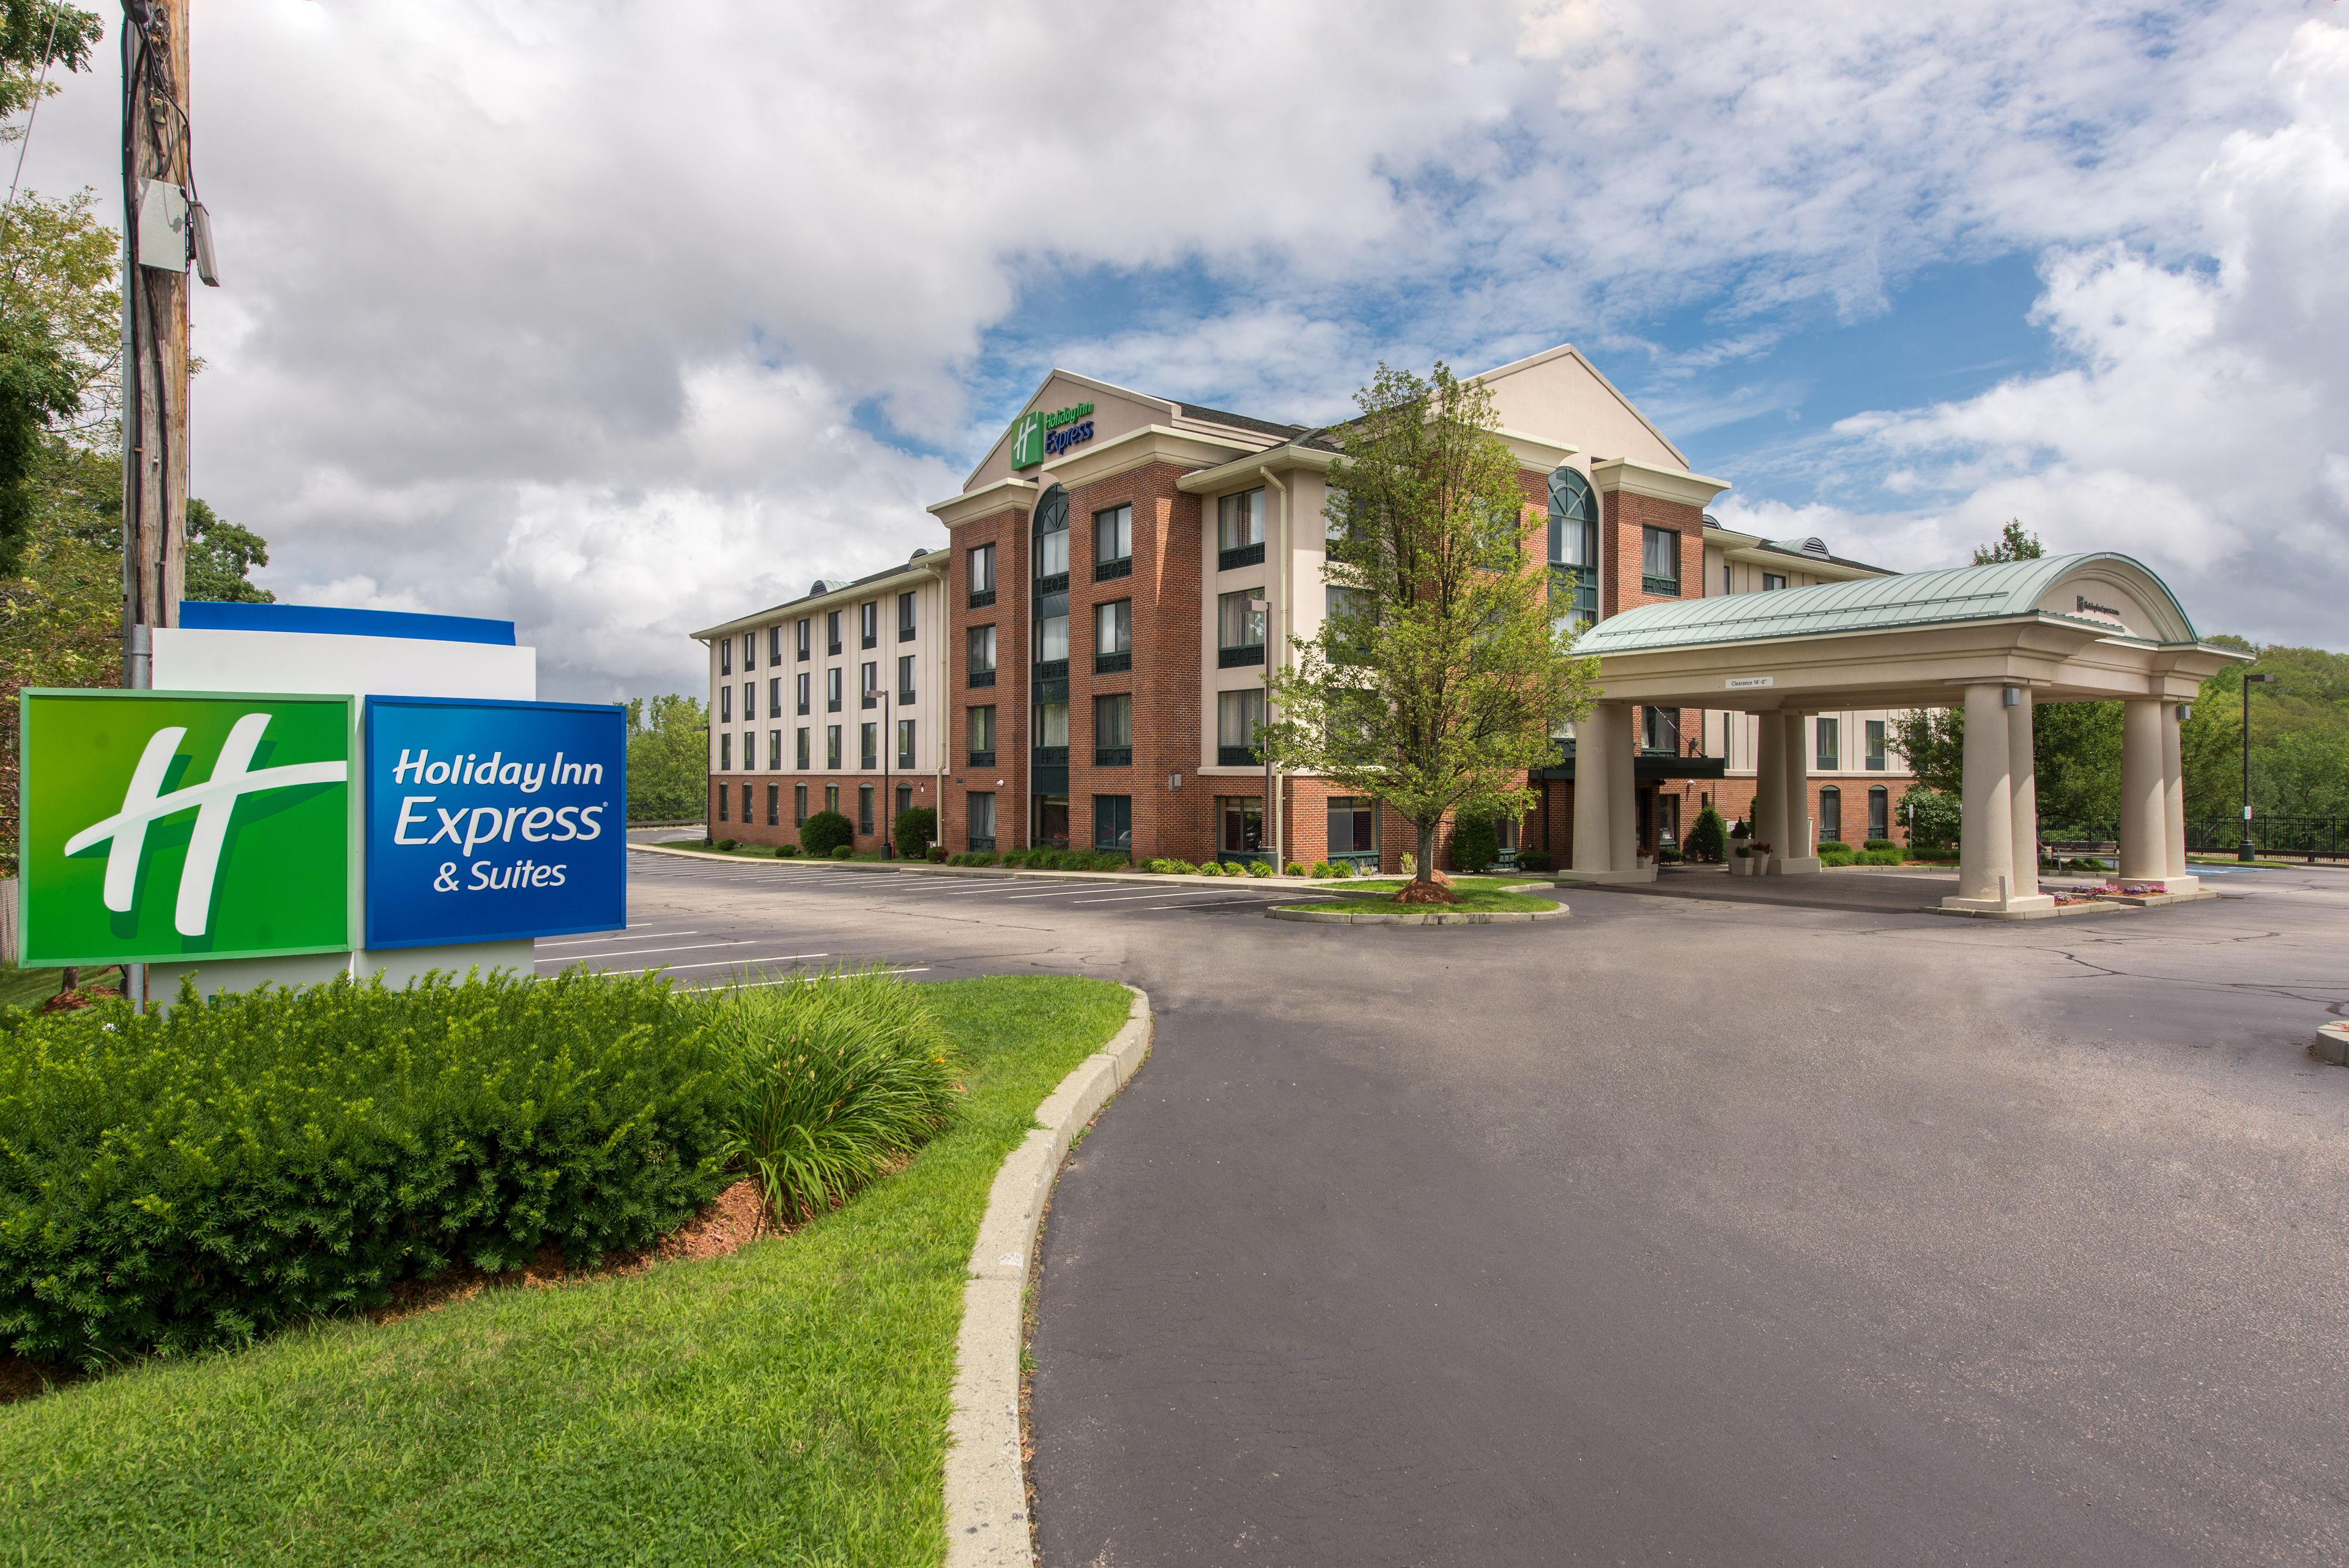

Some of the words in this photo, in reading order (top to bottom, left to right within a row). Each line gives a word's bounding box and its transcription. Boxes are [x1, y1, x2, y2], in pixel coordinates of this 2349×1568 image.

[1045, 407, 1077, 430] Holiday
[1077, 401, 1093, 417] Inn
[1045, 421, 1094, 455] Express
[392, 749, 546, 793] Holiday
[551, 751, 603, 786] Inn
[433, 862, 459, 892] &
[467, 860, 567, 891] Suites
